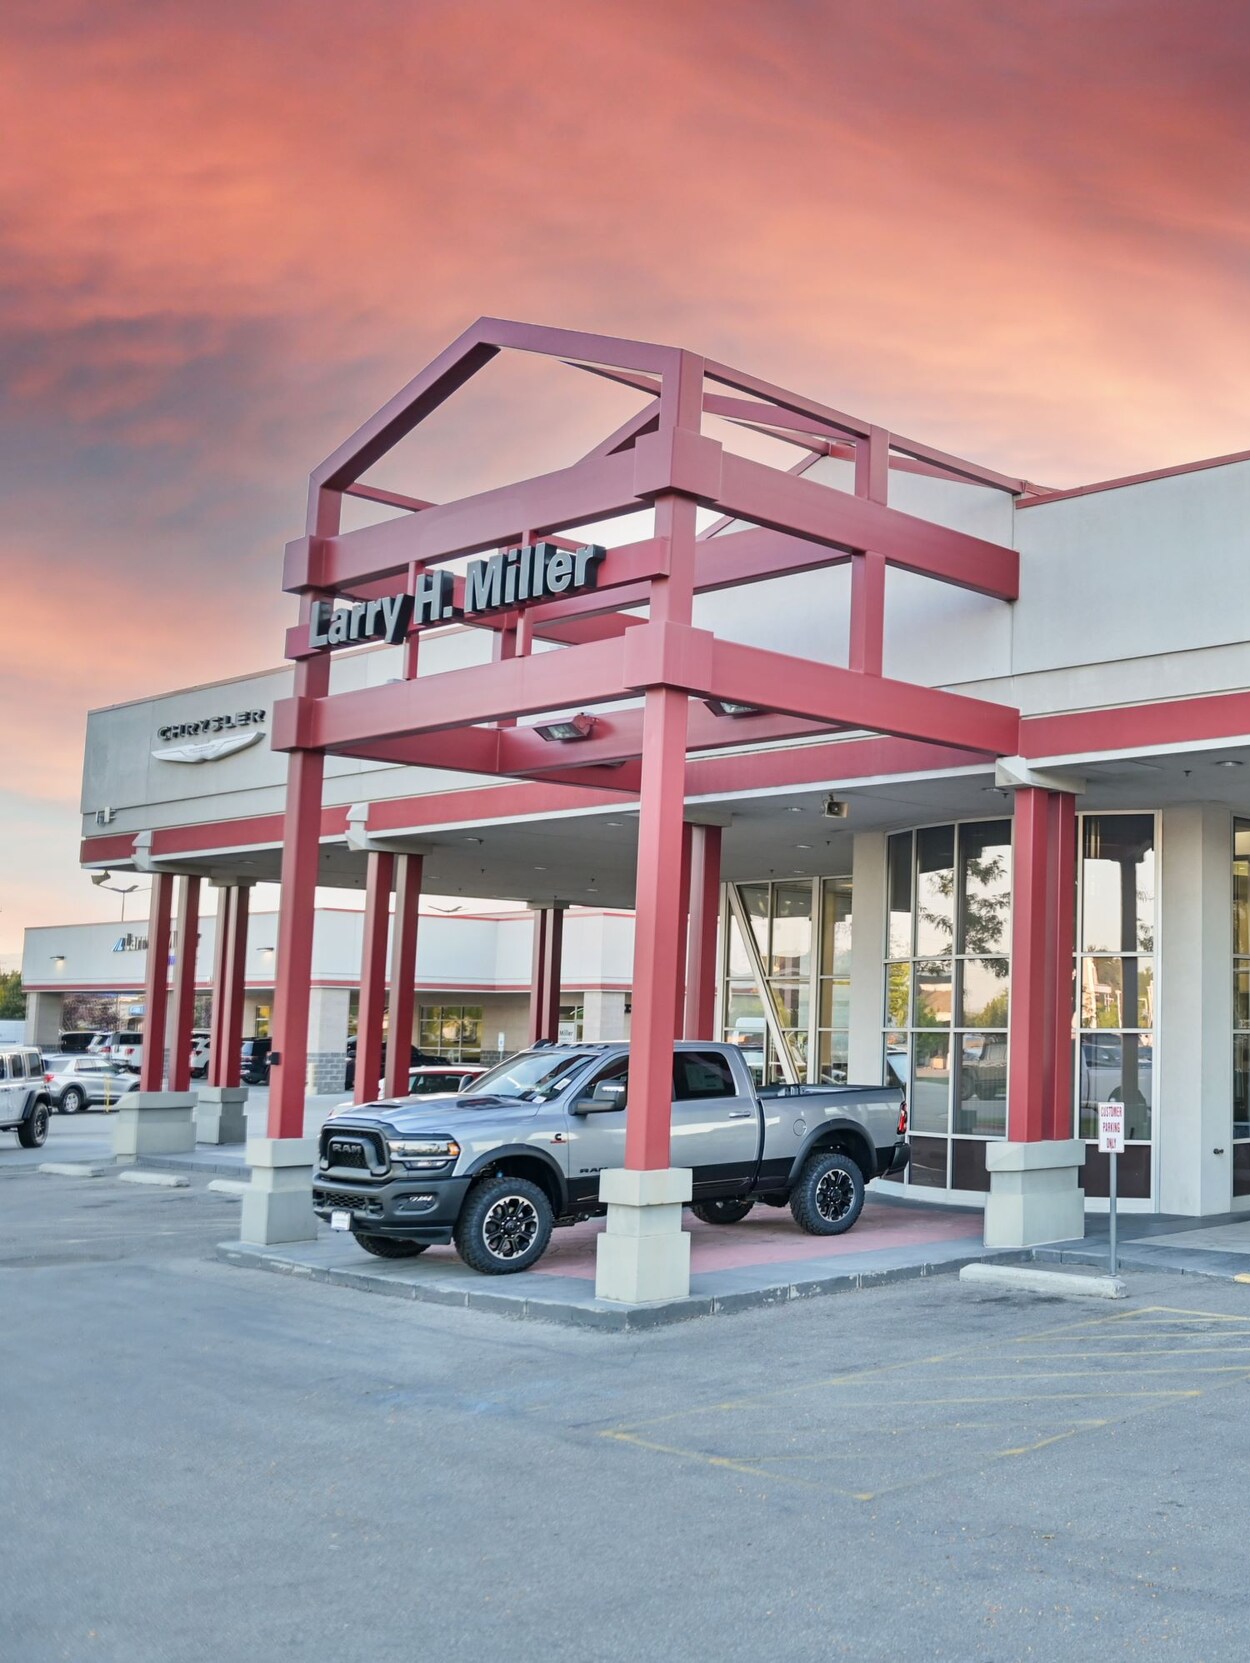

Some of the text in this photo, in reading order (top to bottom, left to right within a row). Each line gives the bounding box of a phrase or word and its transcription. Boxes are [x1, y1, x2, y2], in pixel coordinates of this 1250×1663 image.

[309, 542, 607, 648] Larry H. Miller
[158, 709, 267, 741] CHRYSLER
[1100, 1106, 1122, 1118] CUSTOMER
[1102, 1121, 1120, 1133] PARKING
[332, 1143, 362, 1153] RAM
